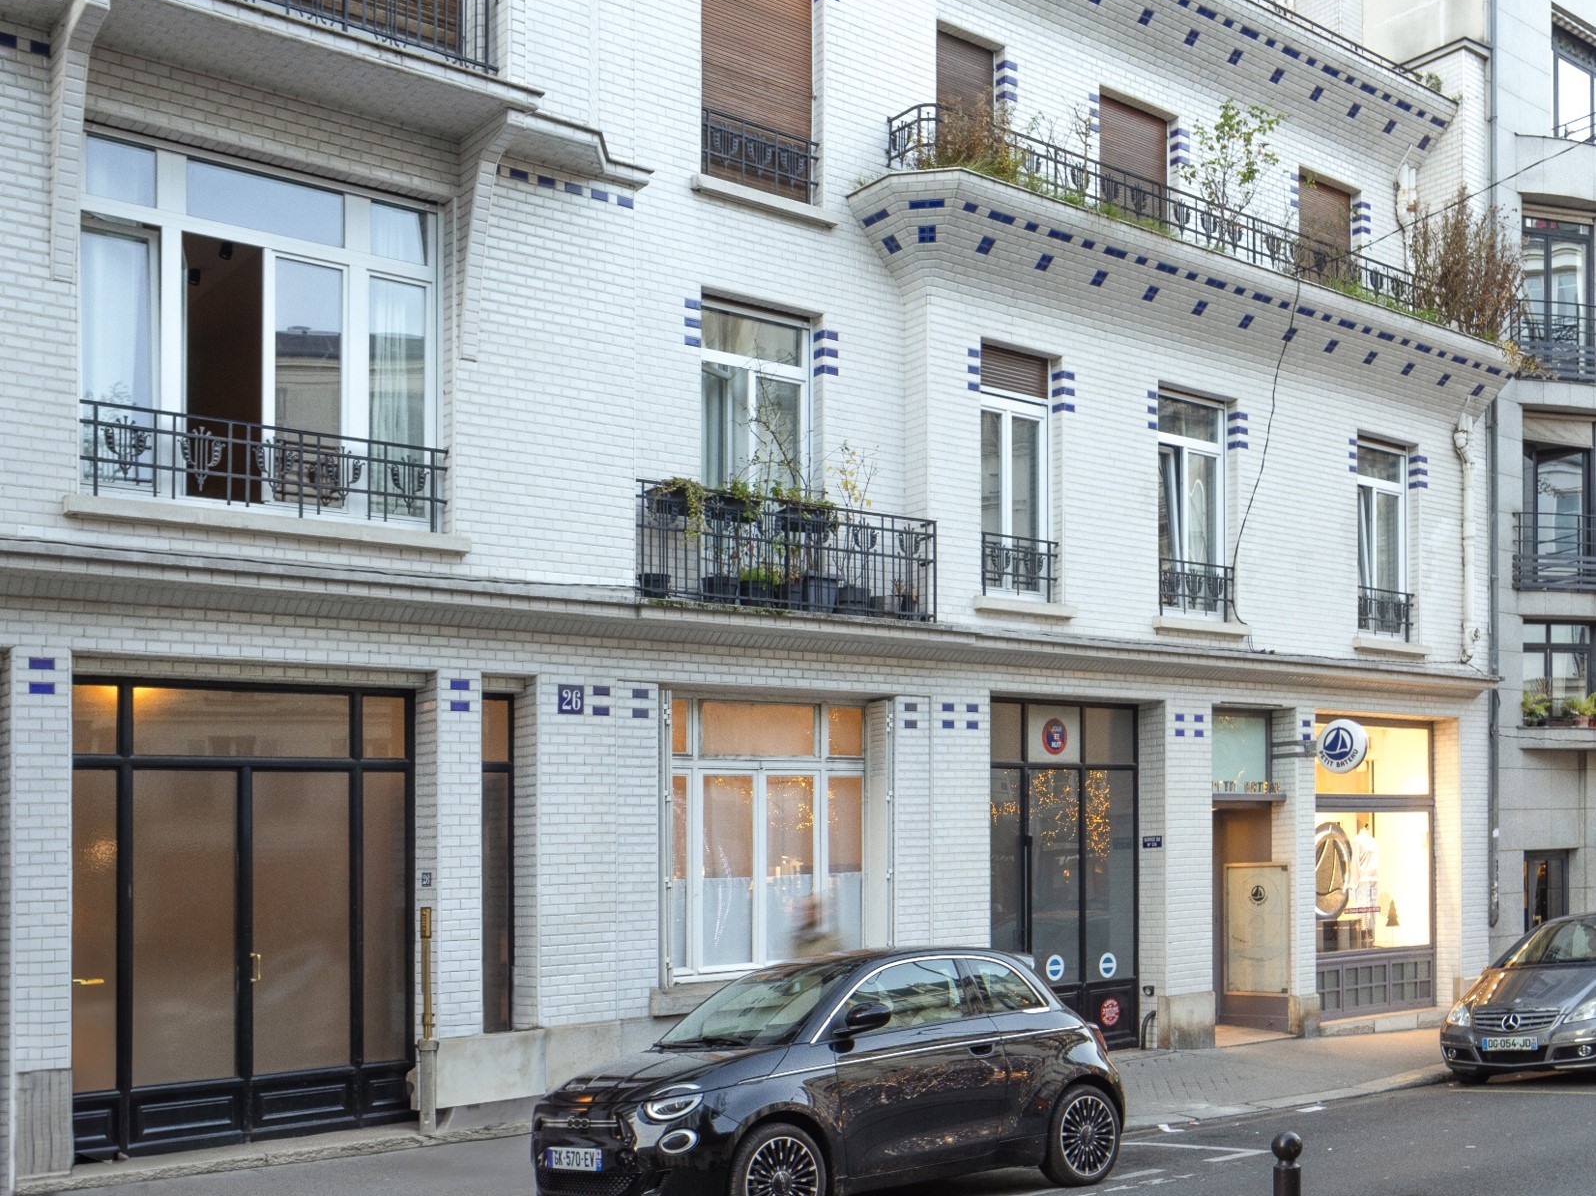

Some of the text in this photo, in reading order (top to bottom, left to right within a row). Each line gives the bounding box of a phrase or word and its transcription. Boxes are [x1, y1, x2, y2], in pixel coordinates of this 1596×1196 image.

[562, 689, 581, 710] 26
[1319, 749, 1359, 768] PETIT BATEAU
[1488, 1038, 1531, 1048] DG-054-JD
[554, 1150, 595, 1168] GK-570-EV
